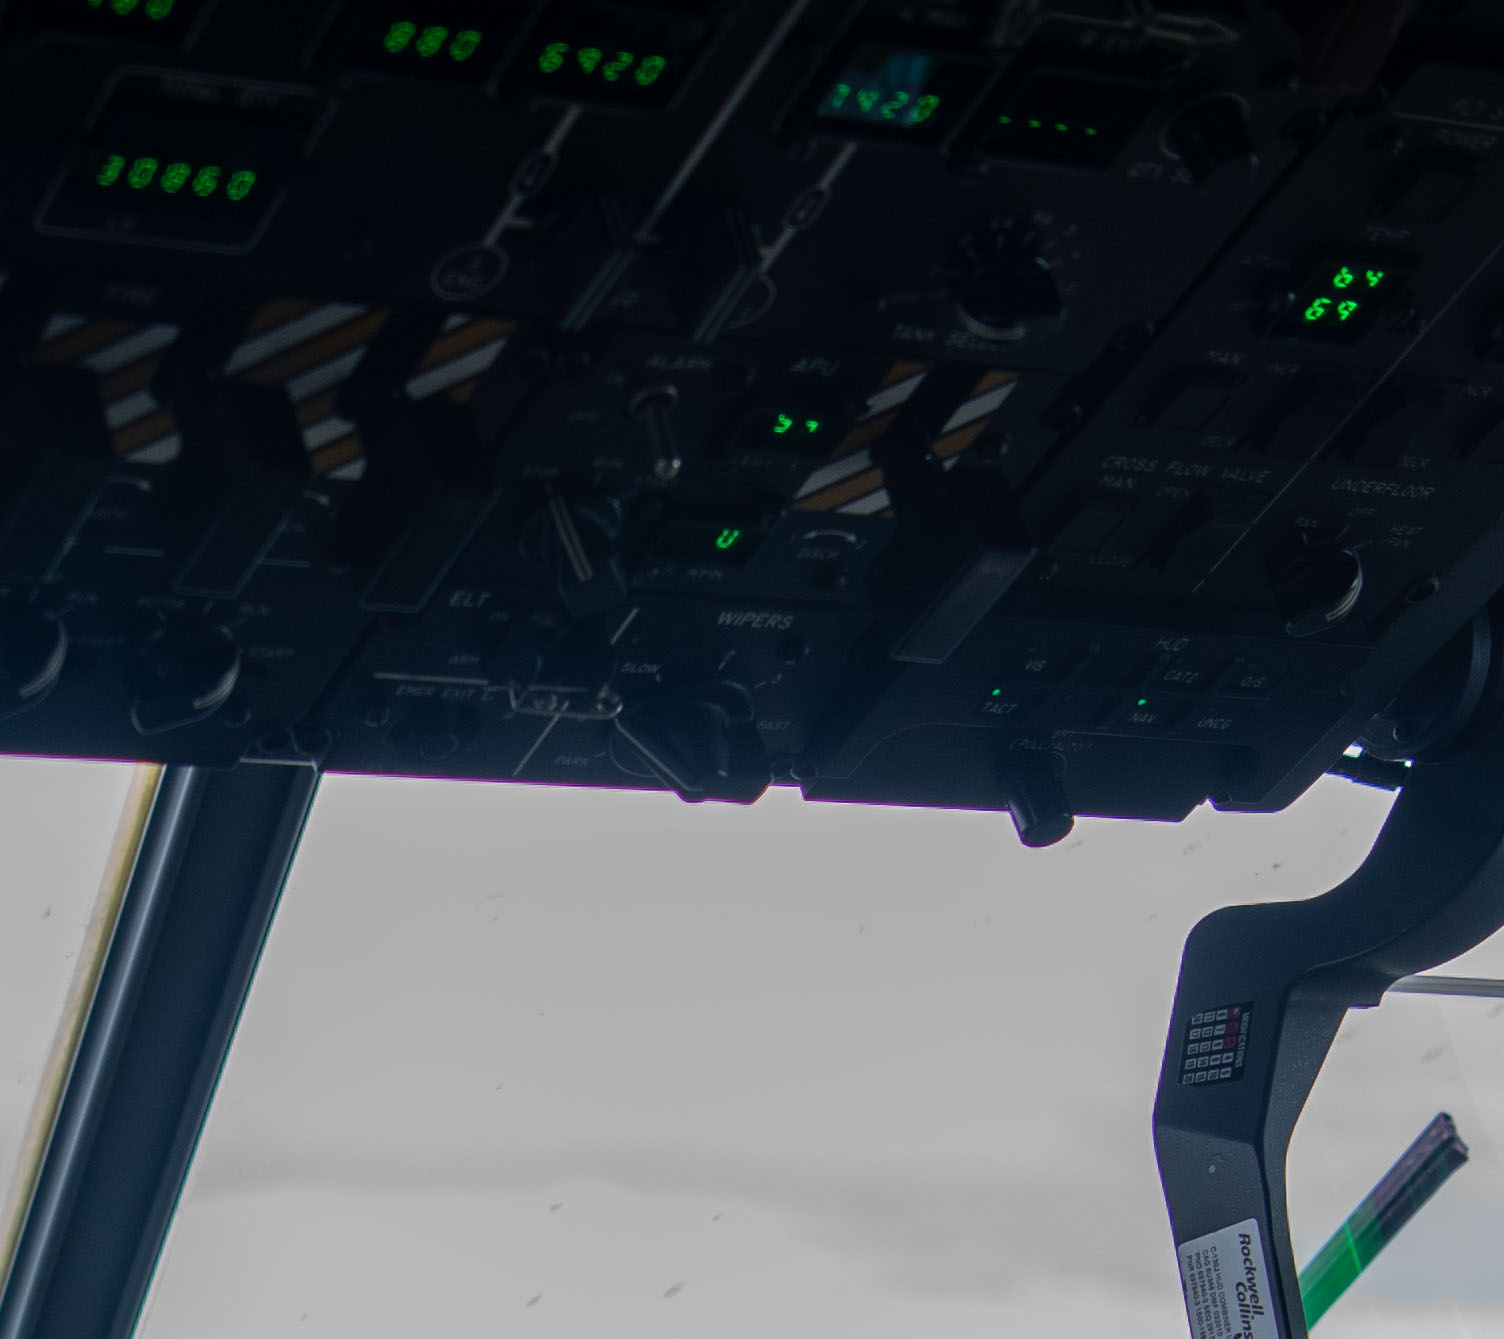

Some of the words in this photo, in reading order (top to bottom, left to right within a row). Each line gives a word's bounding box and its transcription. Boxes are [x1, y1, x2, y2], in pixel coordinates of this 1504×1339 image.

[718, 611, 794, 629] WIPERS
[1238, 1233, 1264, 1315] Rockwell
[1235, 1282, 1253, 1339] Collins
